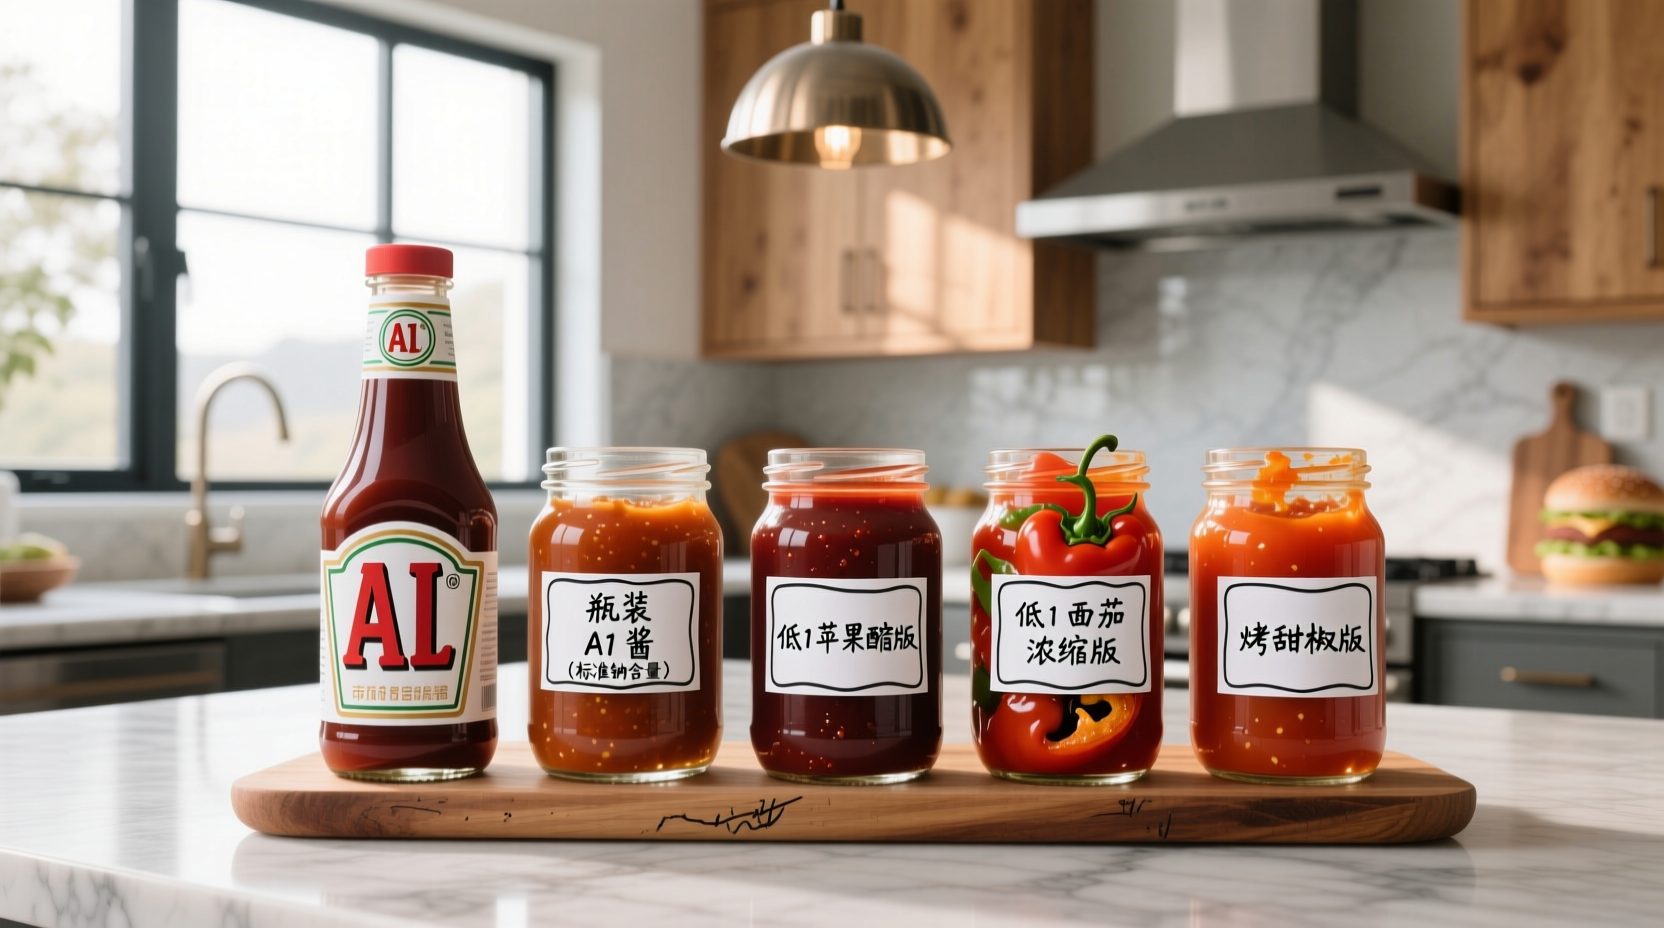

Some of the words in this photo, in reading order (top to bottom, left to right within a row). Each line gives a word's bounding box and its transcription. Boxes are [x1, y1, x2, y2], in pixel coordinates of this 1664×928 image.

[586, 591, 652, 624] 瓶装
[584, 631, 615, 656] A1
[626, 625, 654, 660] 酱
[1026, 634, 1121, 666] 浓缩版
[1239, 621, 1366, 656] 烤甜椒版
